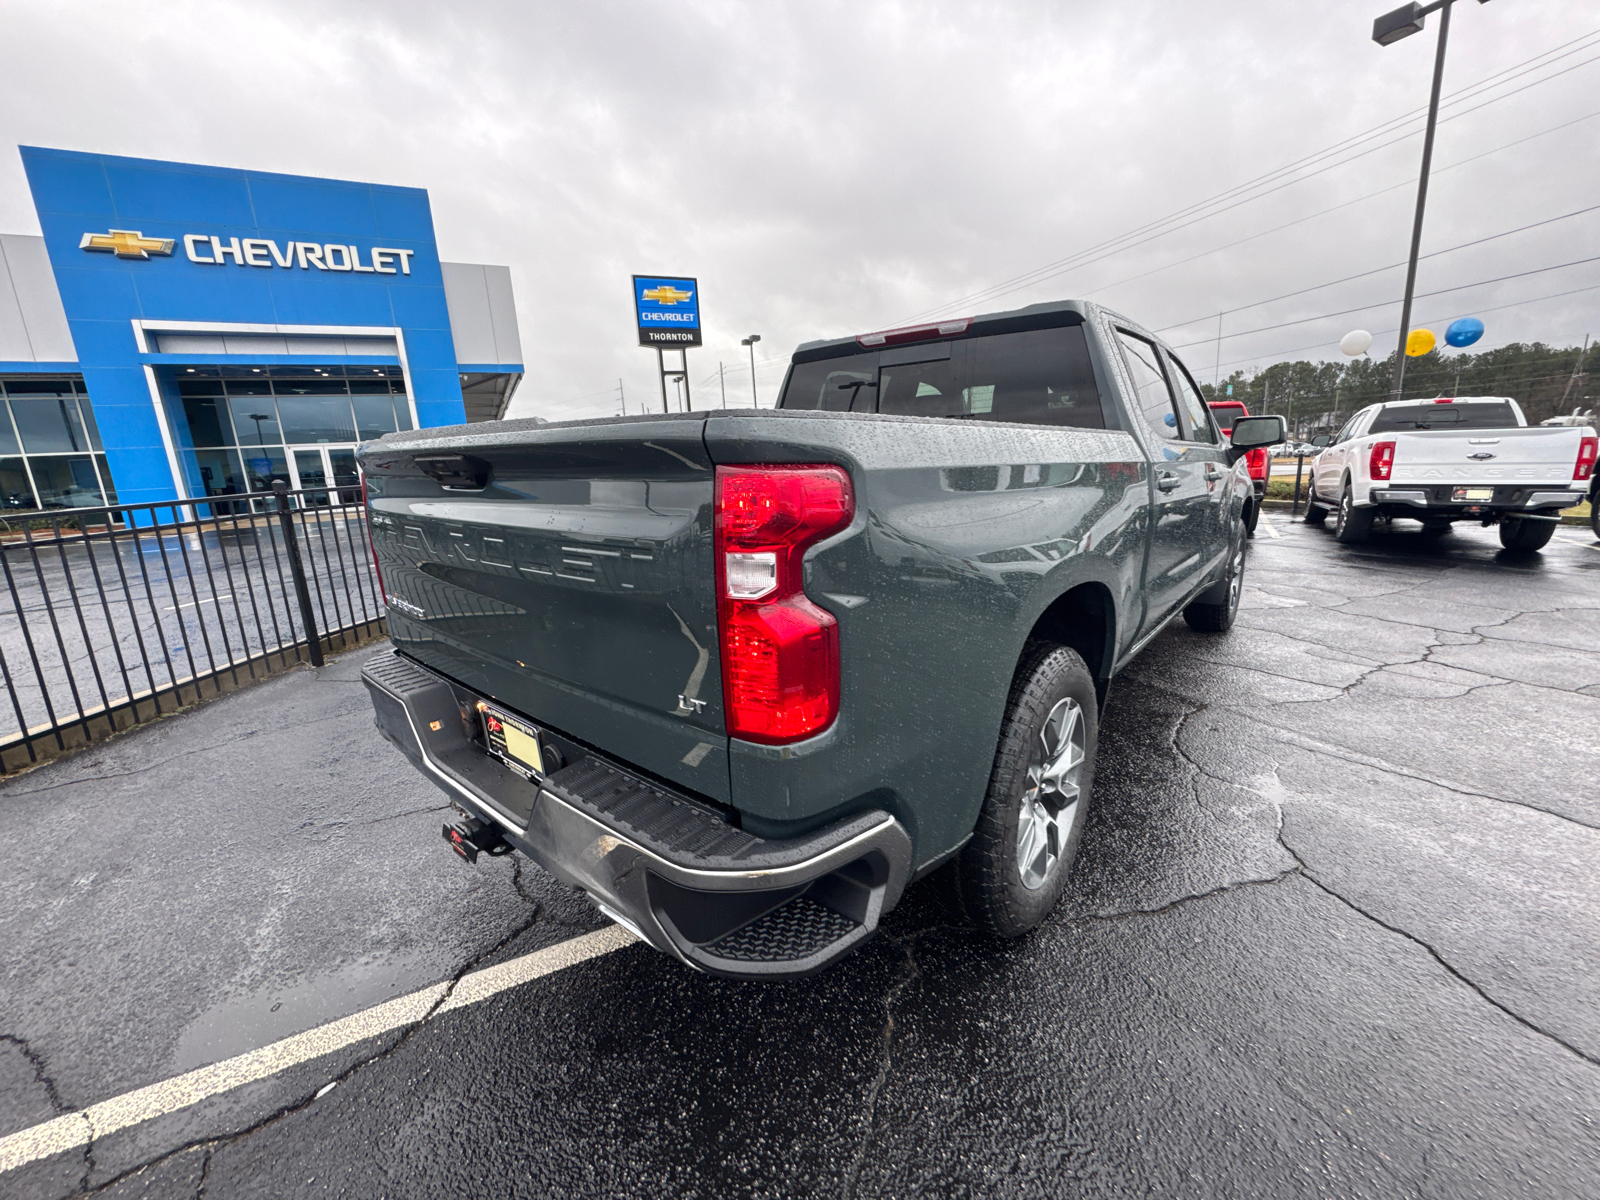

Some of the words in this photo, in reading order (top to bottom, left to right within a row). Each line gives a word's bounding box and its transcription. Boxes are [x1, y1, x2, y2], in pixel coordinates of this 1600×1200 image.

[183, 234, 414, 275] CHEVROLET
[642, 312, 695, 322] CHEVROLET
[649, 332, 693, 341] THORNTON
[1396, 468, 1568, 478] RANGER
[678, 694, 707, 715] LT
